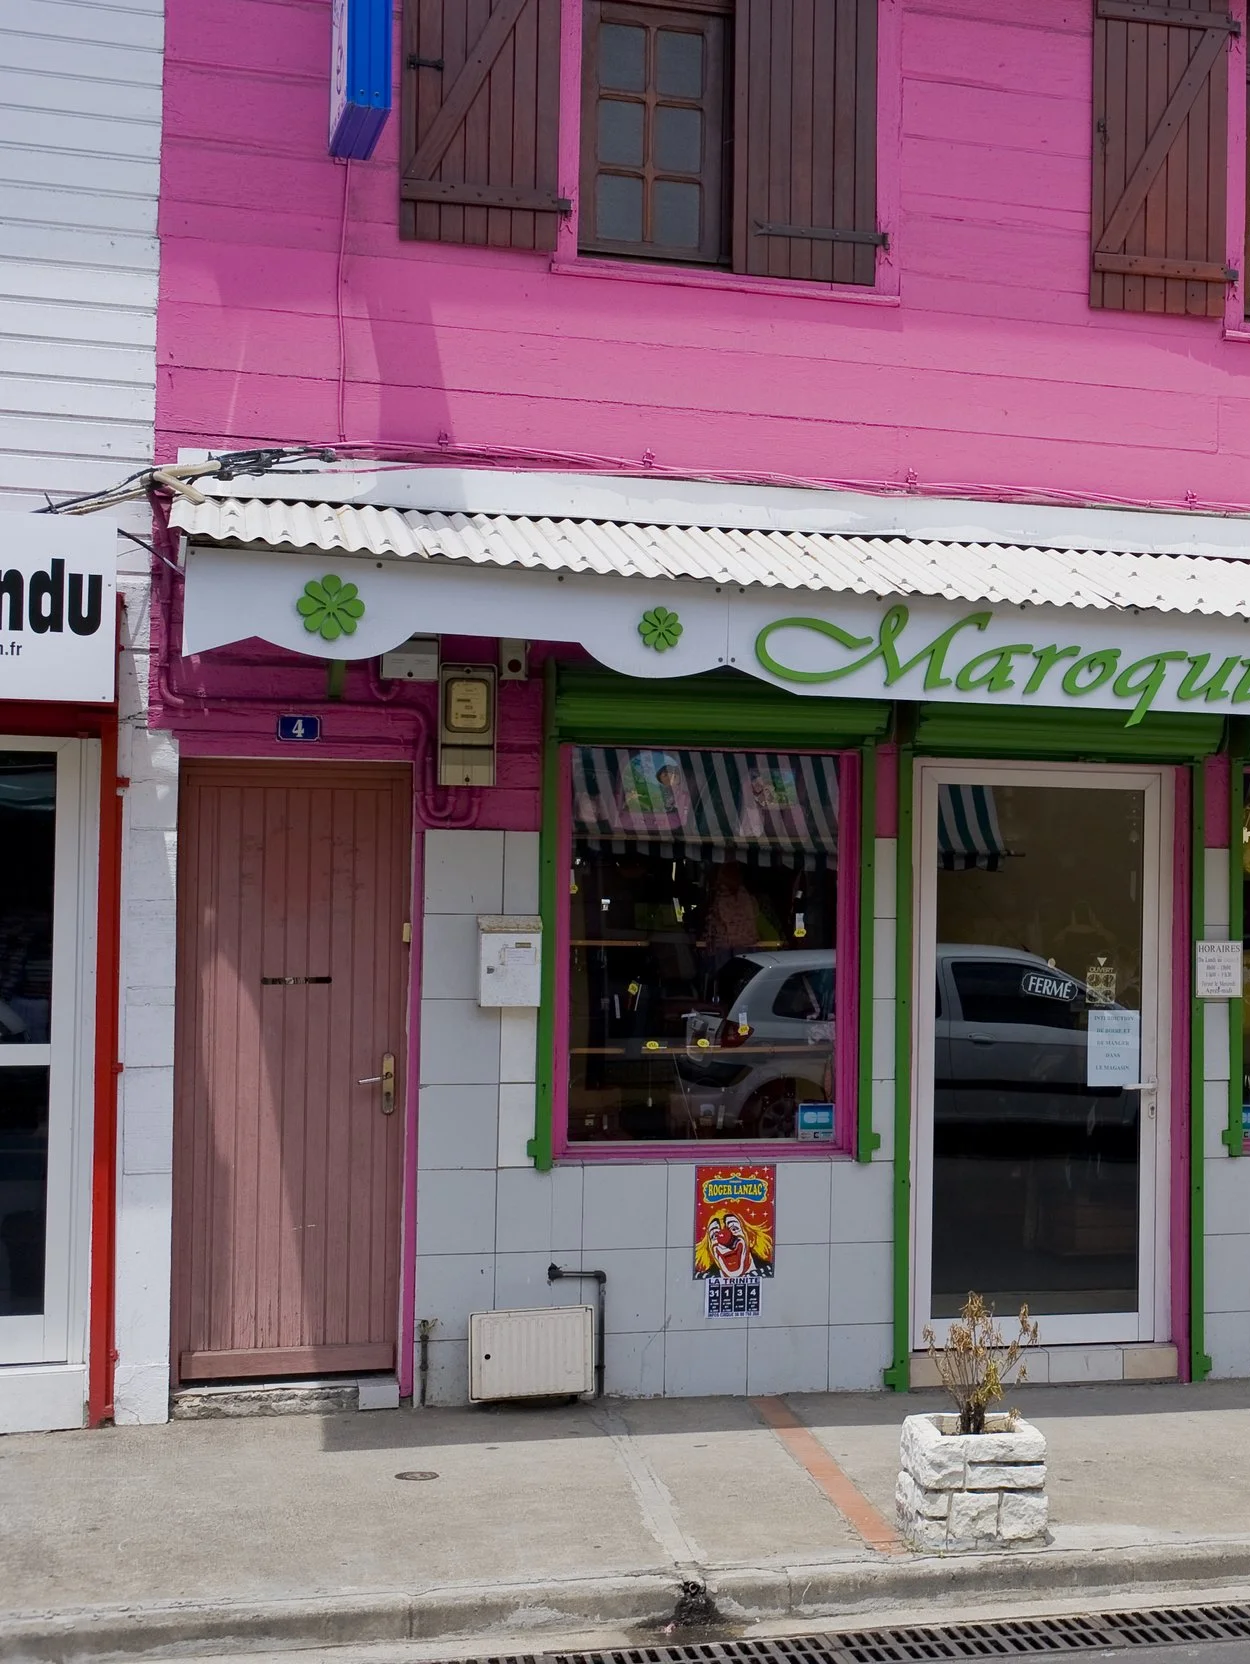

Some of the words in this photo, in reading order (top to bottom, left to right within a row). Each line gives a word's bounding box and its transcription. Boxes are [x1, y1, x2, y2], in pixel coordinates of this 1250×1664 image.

[291, 719, 305, 738] 4
[1198, 944, 1241, 953] HORAIRES
[1027, 975, 1073, 999] FERMÉ
[708, 1184, 733, 1197] ROGER
[733, 1183, 763, 1196] LANZAC
[709, 1289, 720, 1297] 31
[724, 1289, 730, 1297] 1
[736, 1288, 743, 1297] 3
[750, 1288, 757, 1296] 4
